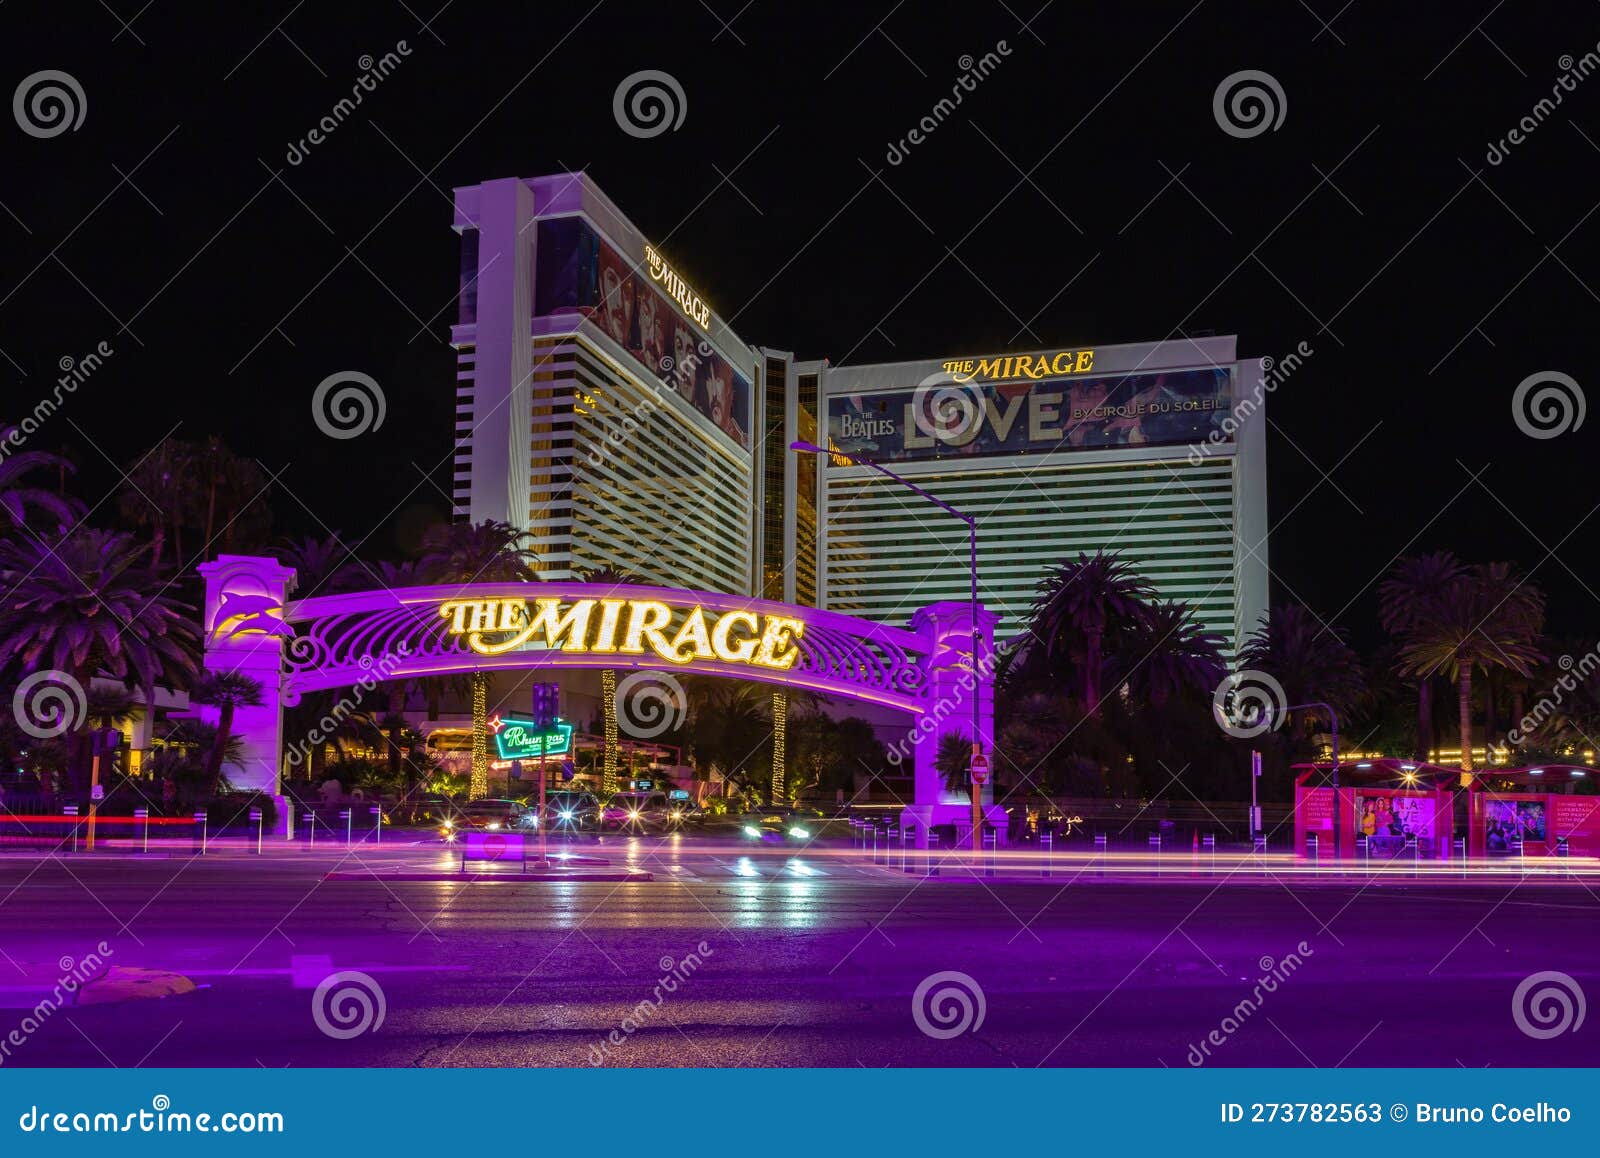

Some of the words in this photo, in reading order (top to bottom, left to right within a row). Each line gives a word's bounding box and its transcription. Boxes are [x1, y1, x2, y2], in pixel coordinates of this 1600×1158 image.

[645, 245, 661, 271] THE
[650, 262, 710, 330] MIRAGE
[942, 360, 974, 375] THE
[952, 350, 1095, 383] MIRAGE
[903, 391, 1064, 451] LOVE
[1073, 408, 1093, 419] BY
[1094, 404, 1146, 419] CIRQUE
[1150, 402, 1170, 414] DU
[1173, 399, 1224, 412] SOLEIL
[841, 414, 895, 440] BEATLES
[439, 599, 525, 634] THE
[469, 598, 805, 670] MIRAGE
